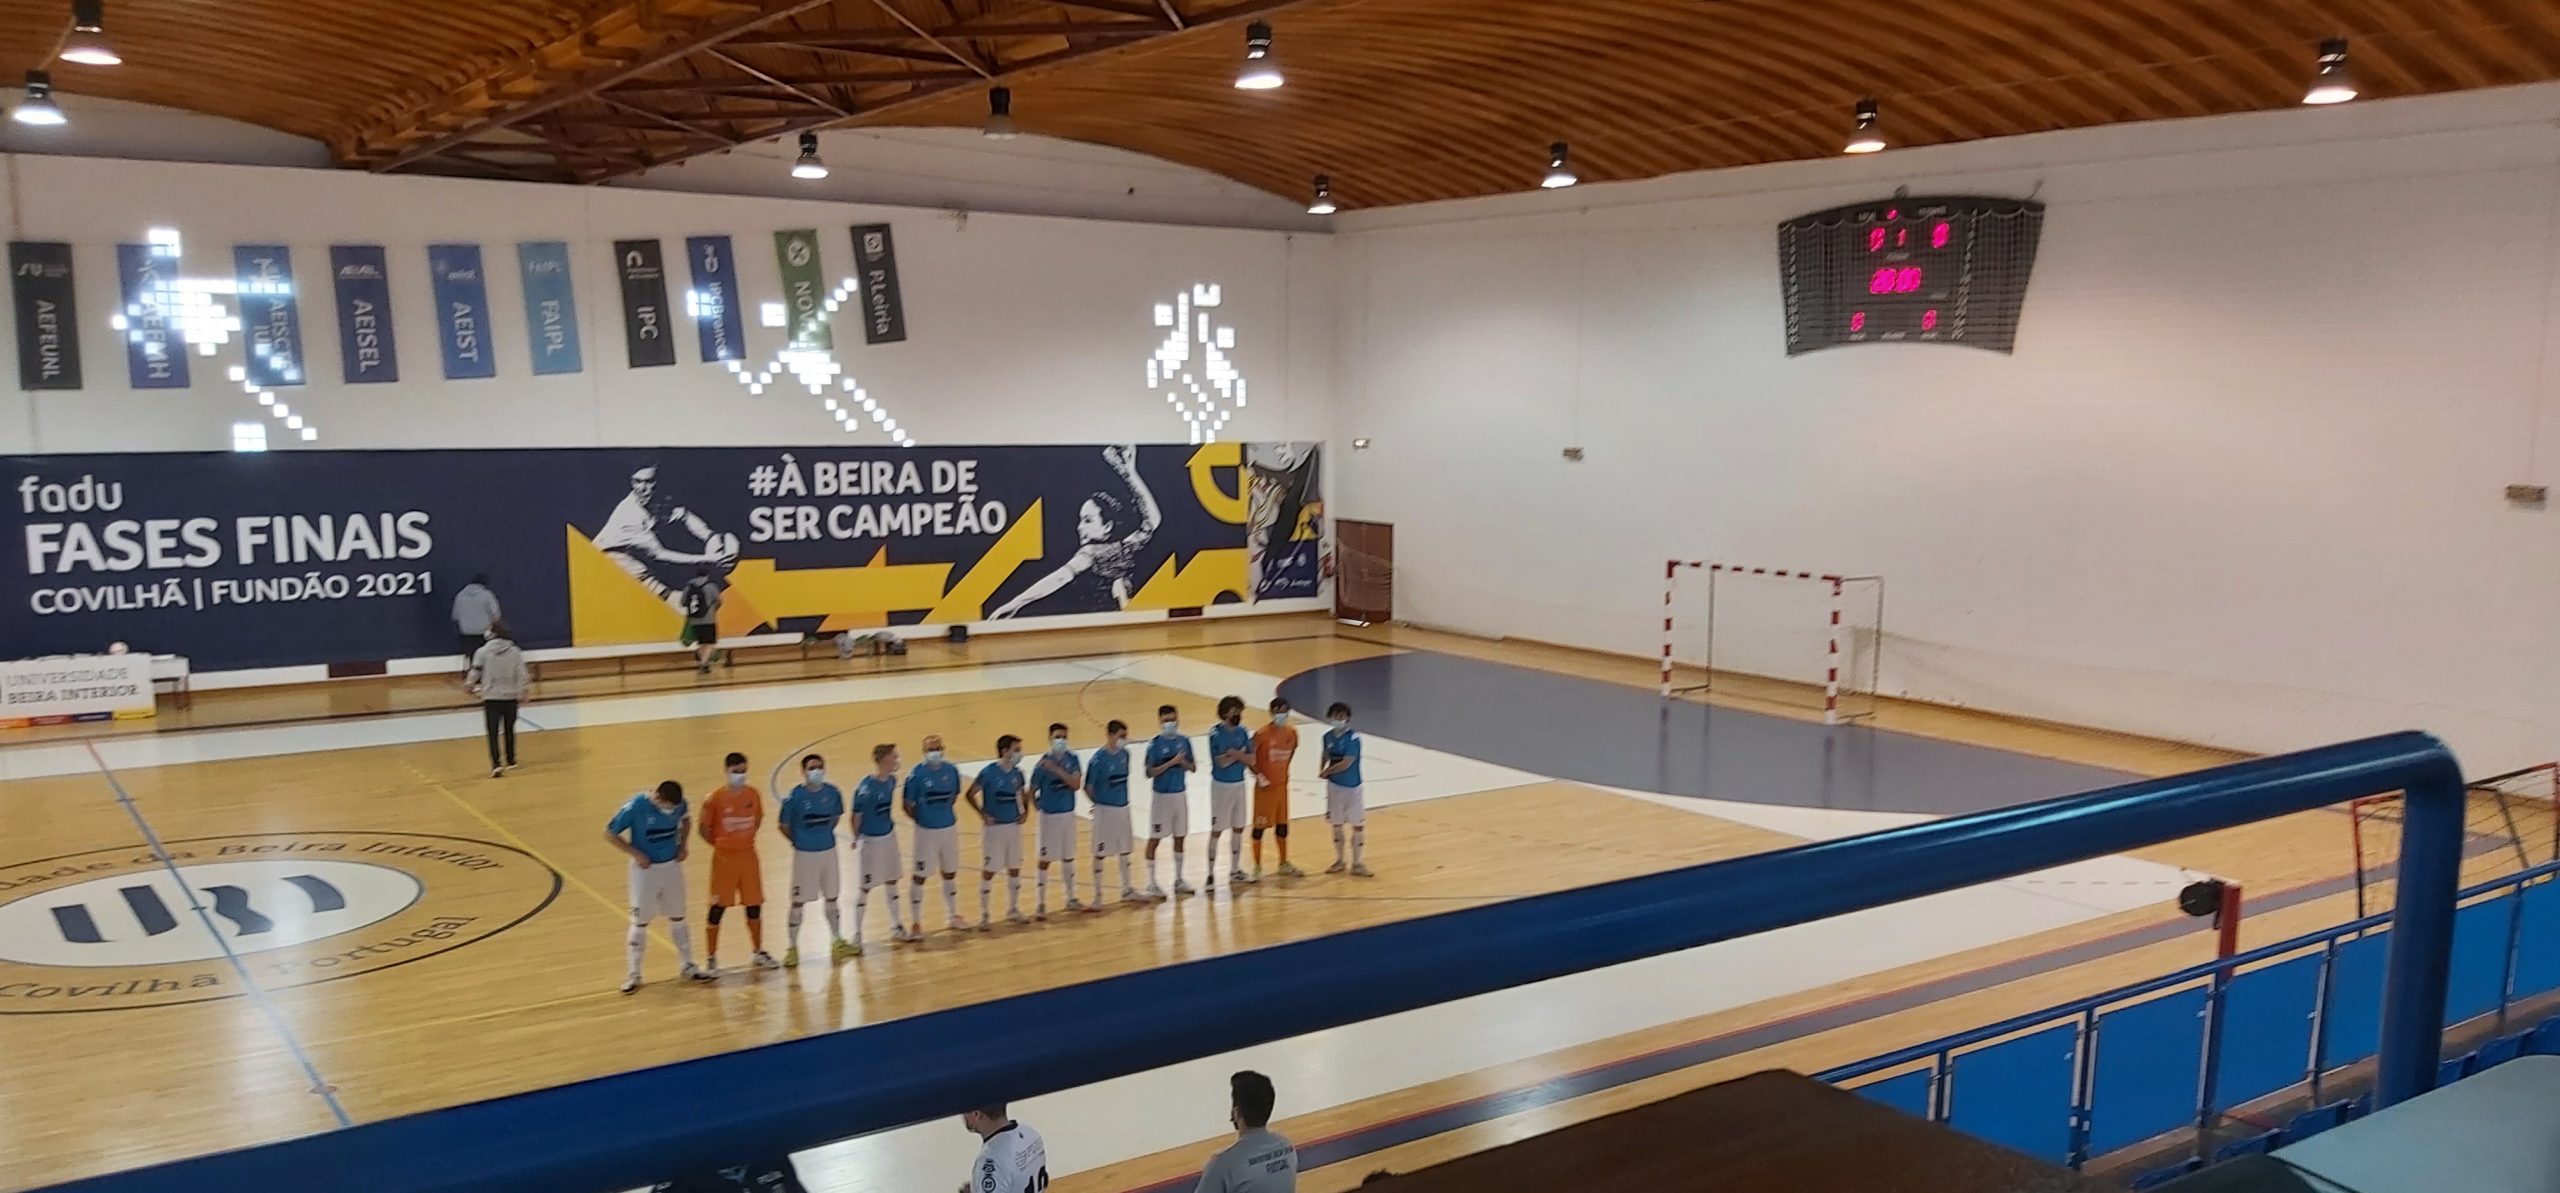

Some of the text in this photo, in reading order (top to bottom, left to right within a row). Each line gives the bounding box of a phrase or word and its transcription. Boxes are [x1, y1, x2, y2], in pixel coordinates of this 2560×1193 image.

[37, 299, 61, 380] AEFEUNL
[353, 299, 380, 374] AEISEL
[452, 302, 479, 362] AEIST
[541, 300, 565, 357] FAIPL
[637, 306, 658, 339] IPC
[17, 474, 123, 513] fadu
[748, 453, 979, 497] #À BEIRA DE
[25, 511, 433, 574] FASES FINAIS
[749, 493, 1008, 543] SER CAMPEÃO
[30, 577, 189, 615] COVILHÃ
[211, 571, 349, 605] FUNDÃO
[355, 571, 433, 598] 2021
[8, 684, 140, 704] BEIRA INTERIOR
[217, 841, 347, 856] Beira
[360, 841, 504, 871] Interior
[0, 915, 480, 998] Covilhã Portugal
